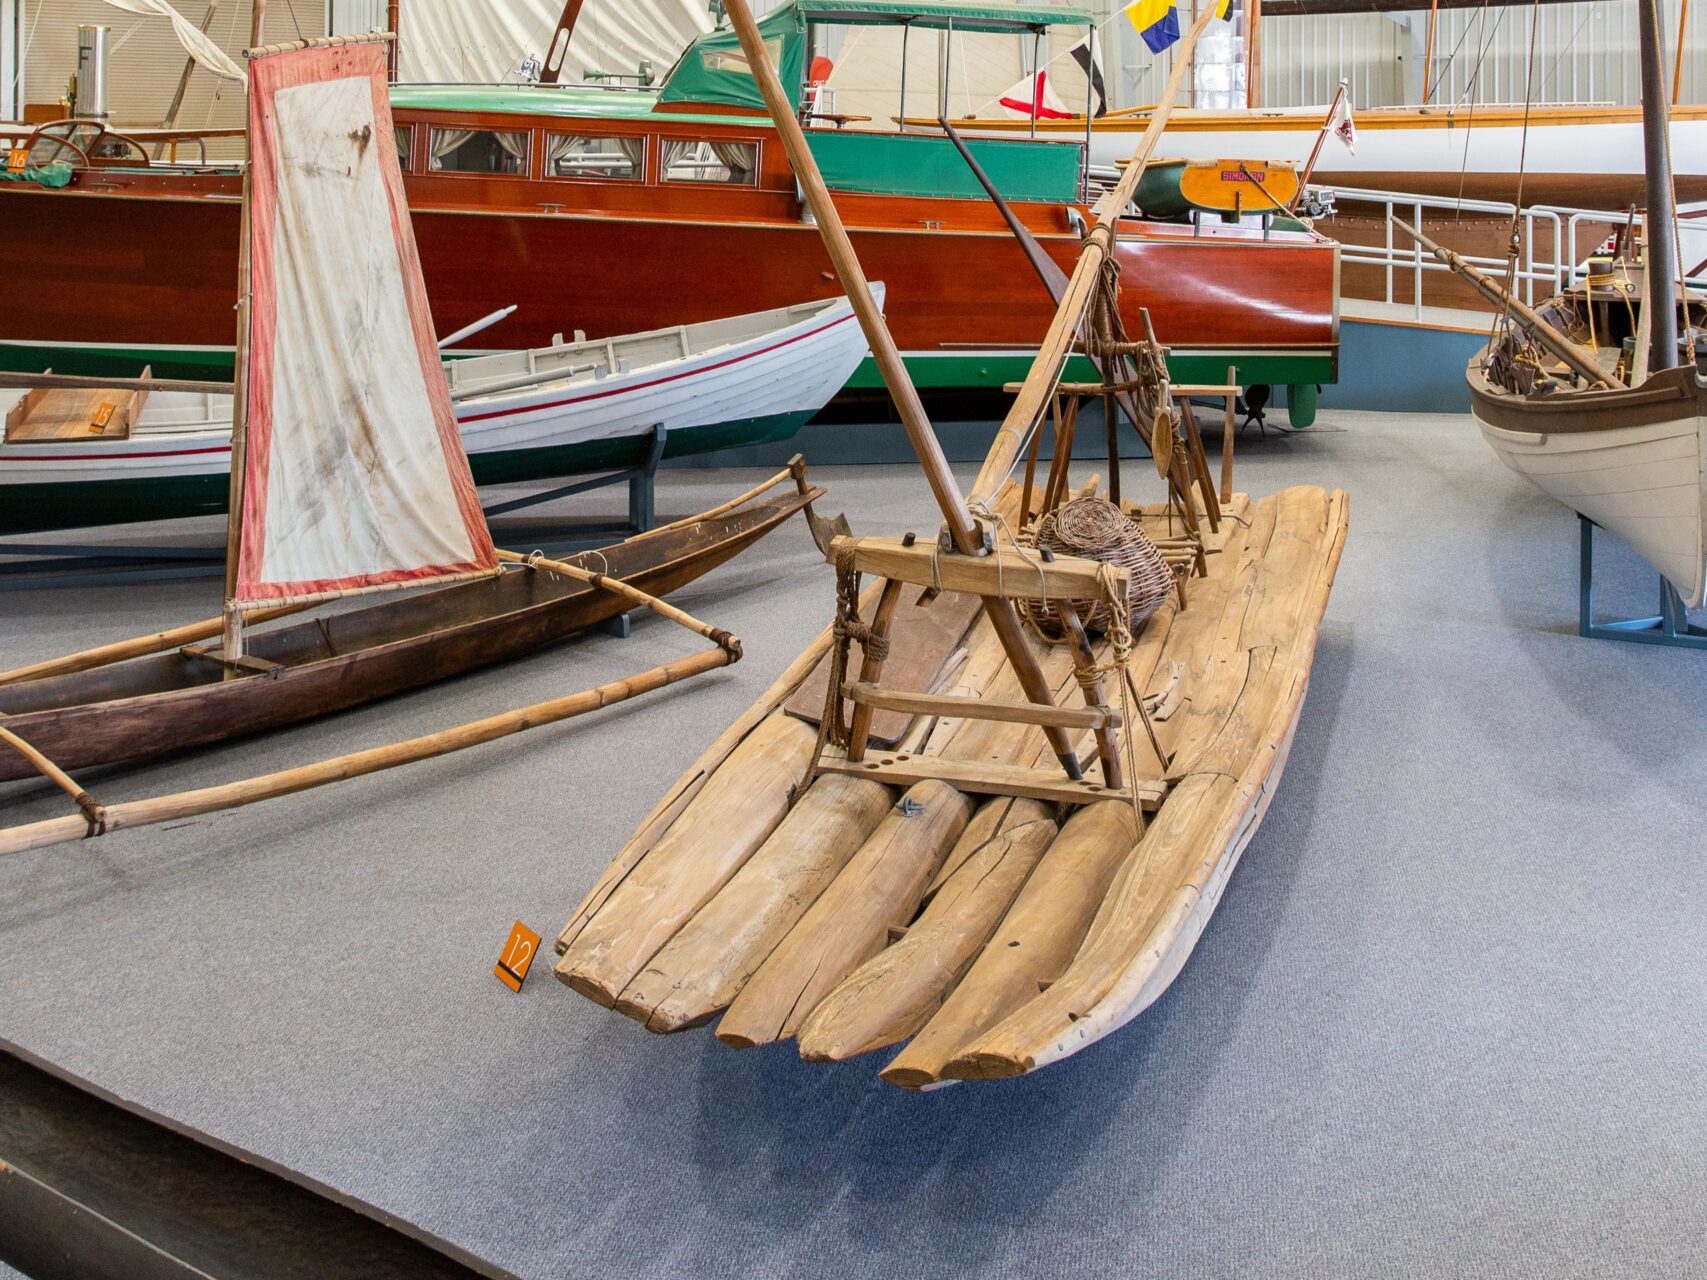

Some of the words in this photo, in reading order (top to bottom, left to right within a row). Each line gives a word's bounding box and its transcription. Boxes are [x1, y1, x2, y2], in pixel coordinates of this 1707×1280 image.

[78, 46, 93, 70] F
[12, 152, 25, 168] 16
[95, 407, 111, 426] 15
[505, 933, 532, 977] 12
